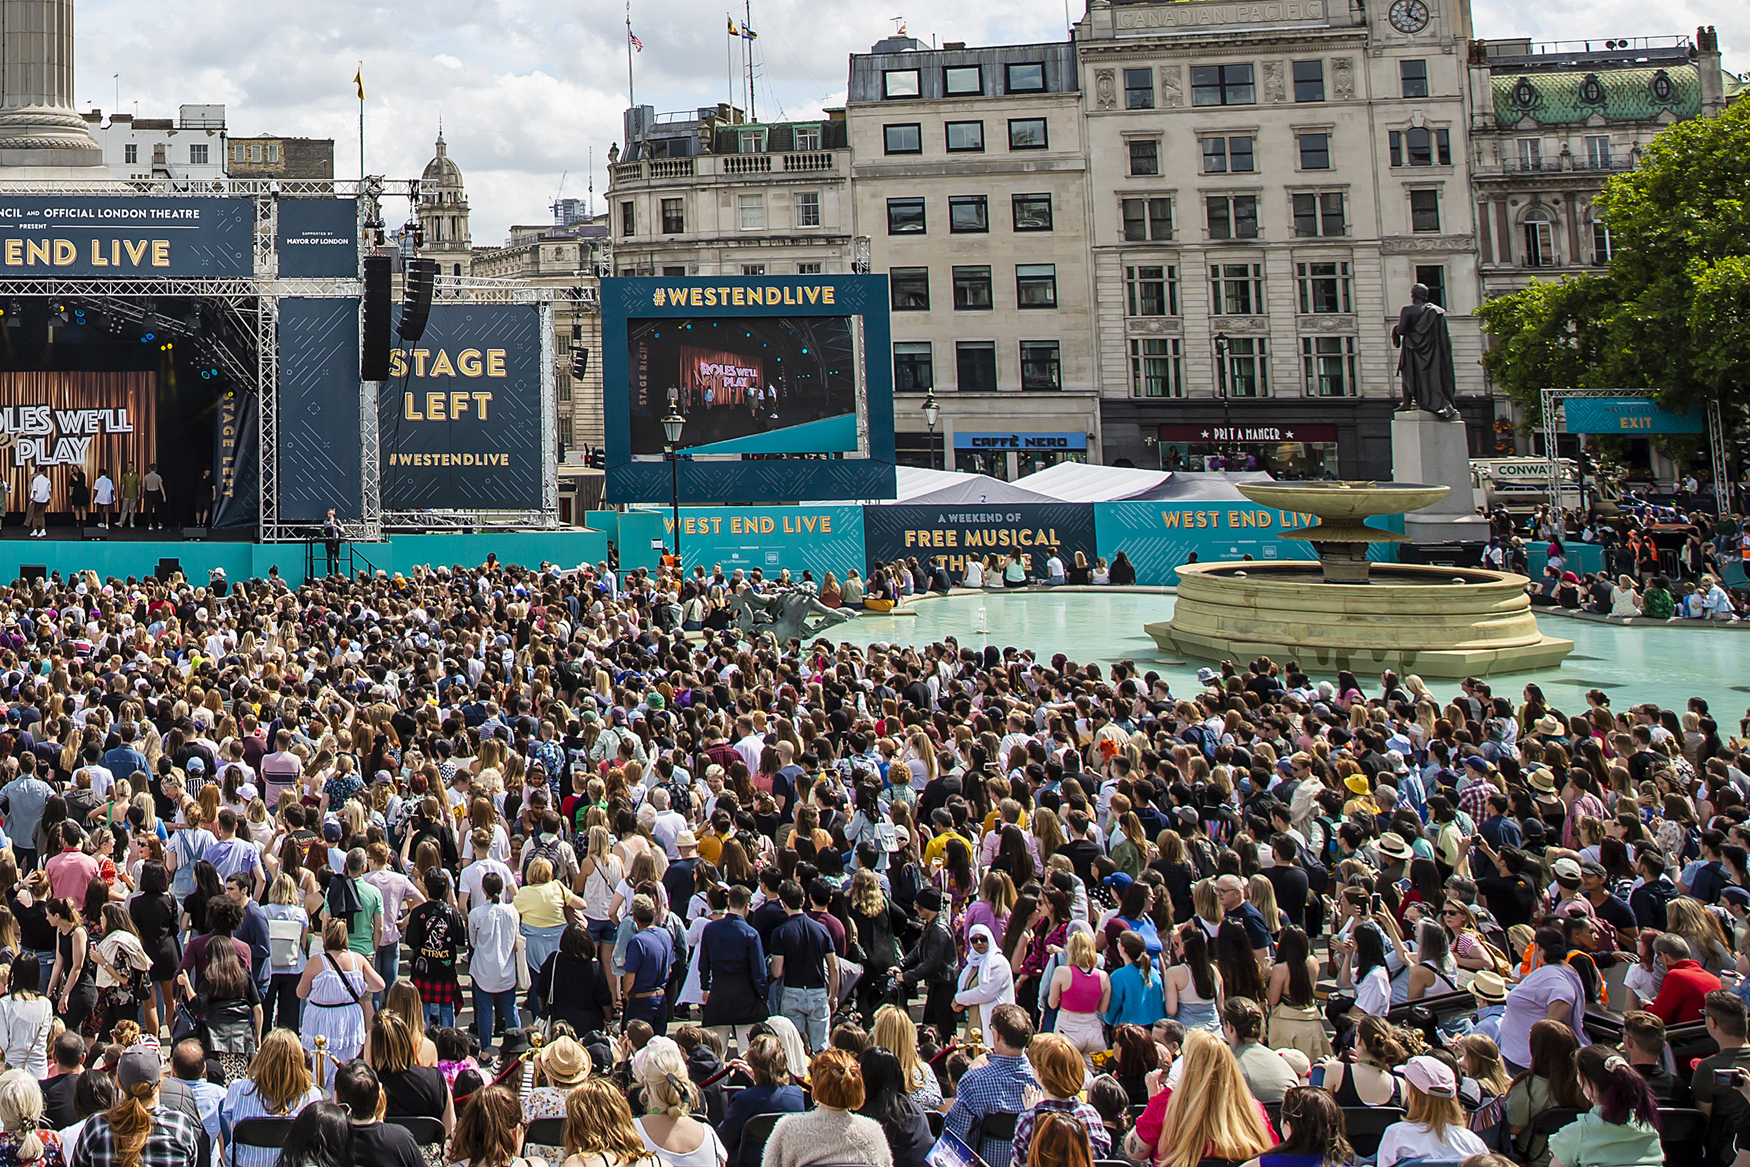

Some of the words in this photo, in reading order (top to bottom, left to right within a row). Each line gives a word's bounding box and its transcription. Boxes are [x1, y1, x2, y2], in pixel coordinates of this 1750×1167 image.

[1119, 7, 1228, 28] CANADIAN
[1236, 2, 1320, 22] PACIFIC
[43, 208, 95, 218] OFFICIAL
[97, 209, 147, 219] LONDON
[149, 209, 200, 219] THEATRE
[5, 238, 78, 267] END
[91, 239, 171, 267] LIVE
[652, 285, 836, 307] #WESTENDLIVE
[389, 348, 507, 378] STAGE
[639, 374, 648, 406] STAGE
[723, 376, 748, 388] PLAY
[404, 391, 493, 421] LEFT
[55, 408, 134, 434] WE'LL
[1619, 417, 1652, 429] EXIT
[971, 434, 1020, 447] CAFFÈ
[1024, 437, 1068, 447] NERO
[1237, 428, 1243, 440] A
[1245, 428, 1281, 440] MANGER
[15, 436, 93, 467] PLAY
[389, 452, 509, 467] #WESTENDLIVE
[222, 456, 234, 498] LEFT
[980, 494, 987, 503] 2
[730, 516, 776, 535] END
[783, 516, 833, 534] LIVE
[937, 513, 947, 523] A
[948, 513, 1003, 523] WEEKEND
[1005, 513, 1022, 523] OF
[1161, 510, 1220, 529] WEST
[1227, 510, 1273, 528] END
[905, 530, 958, 547] FREE
[965, 528, 1061, 547] MUSICAL
